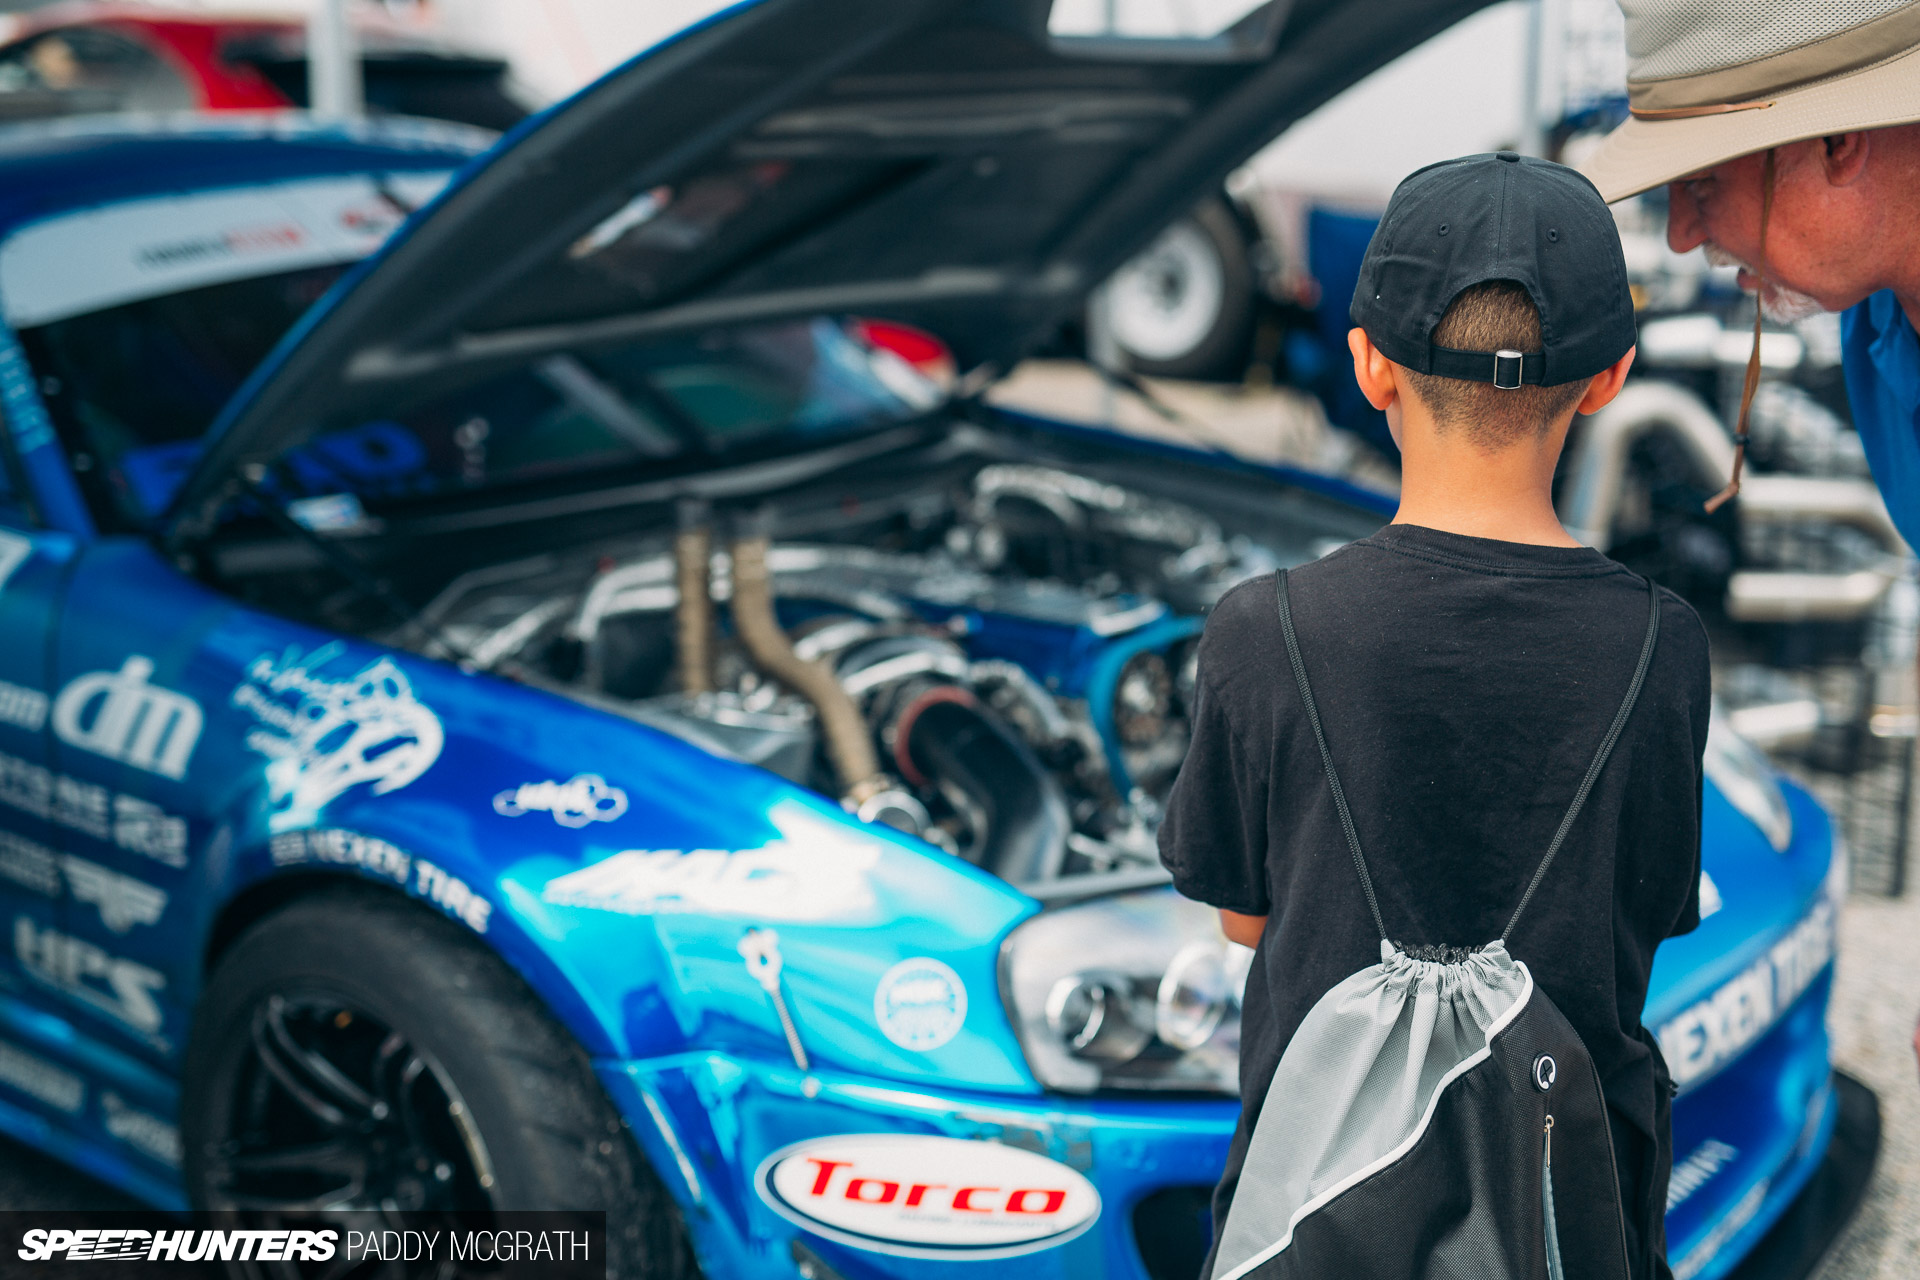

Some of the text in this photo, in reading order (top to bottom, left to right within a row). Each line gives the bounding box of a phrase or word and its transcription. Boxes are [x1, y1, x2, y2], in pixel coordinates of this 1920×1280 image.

[307, 829, 411, 884] NEXEN
[414, 859, 492, 934] TIRE
[806, 1157, 1067, 1214] Torco
